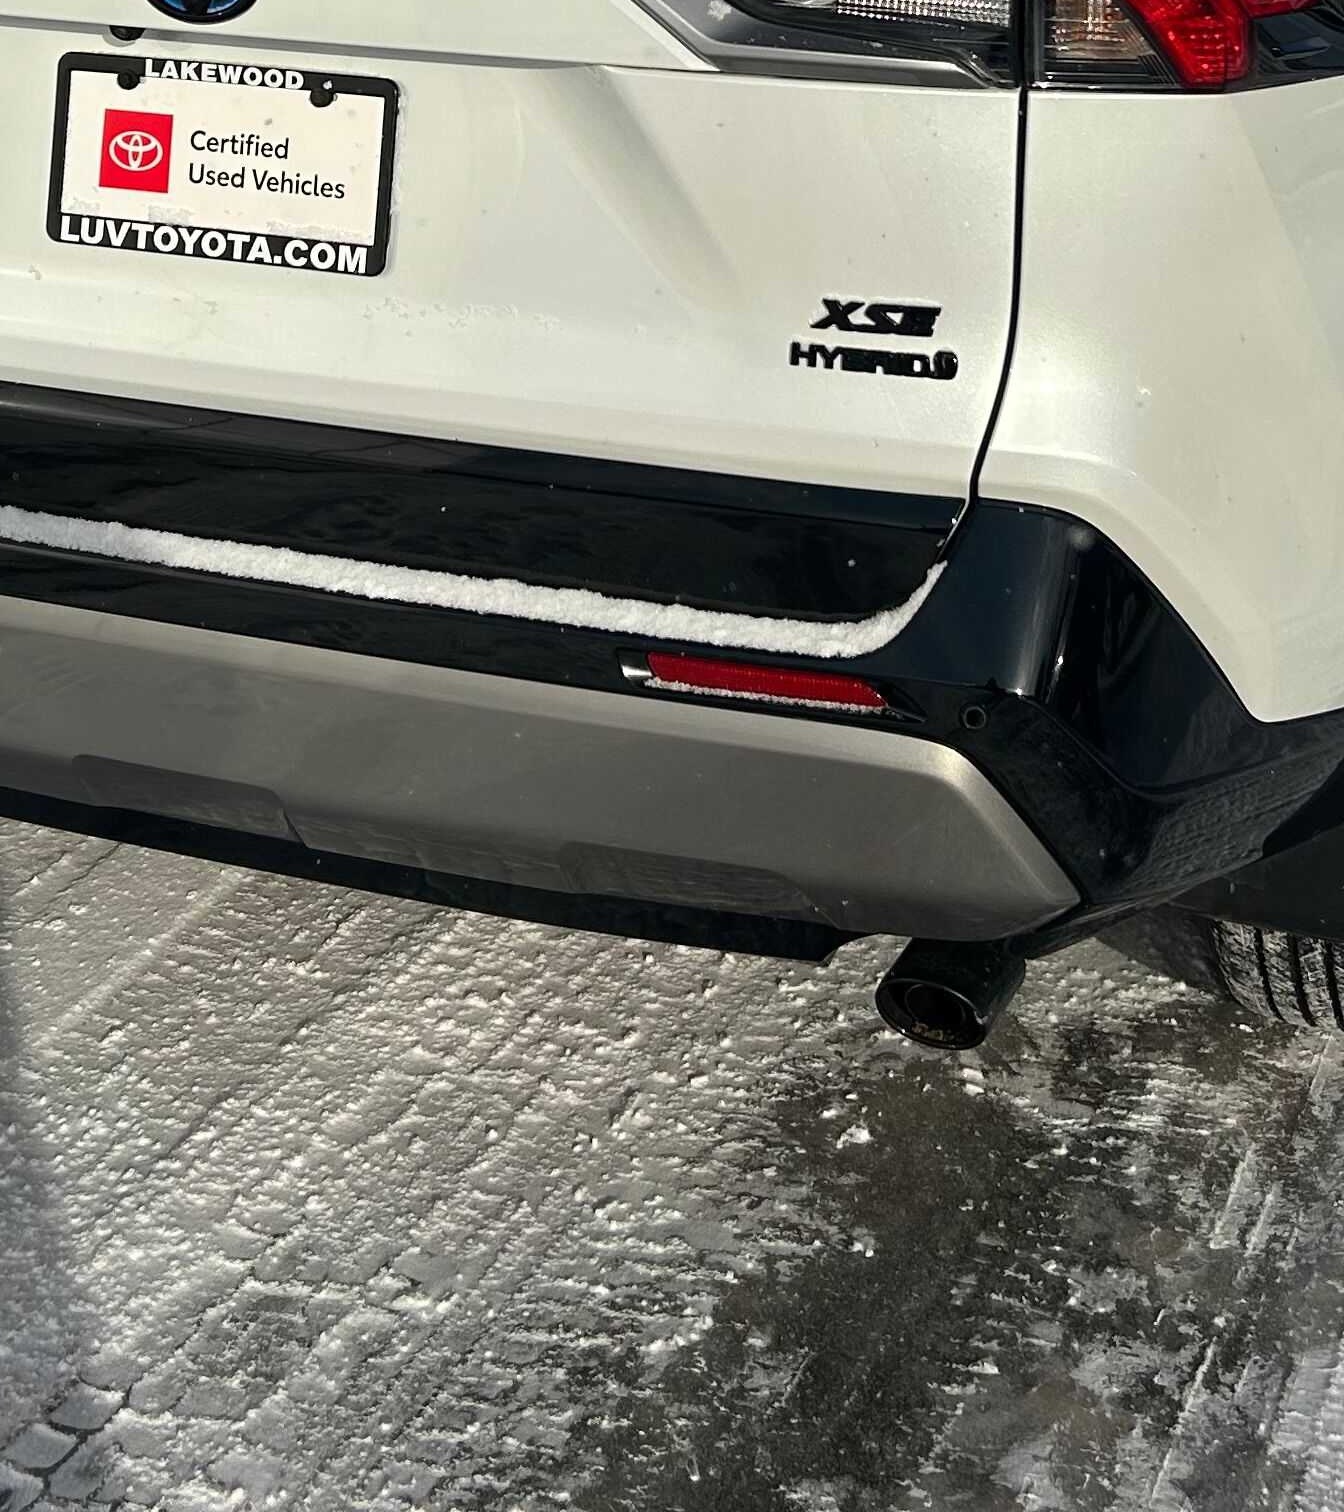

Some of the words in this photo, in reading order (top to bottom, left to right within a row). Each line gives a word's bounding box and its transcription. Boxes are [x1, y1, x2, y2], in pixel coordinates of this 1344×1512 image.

[144, 58, 304, 90] LAKEWOOD
[190, 130, 289, 160] Certified
[189, 163, 245, 189] Used
[252, 169, 346, 200] Vehicles
[59, 216, 368, 274] LUVTOYOTA.COM
[809, 298, 942, 337] XSE
[789, 341, 931, 379] HYBRID
